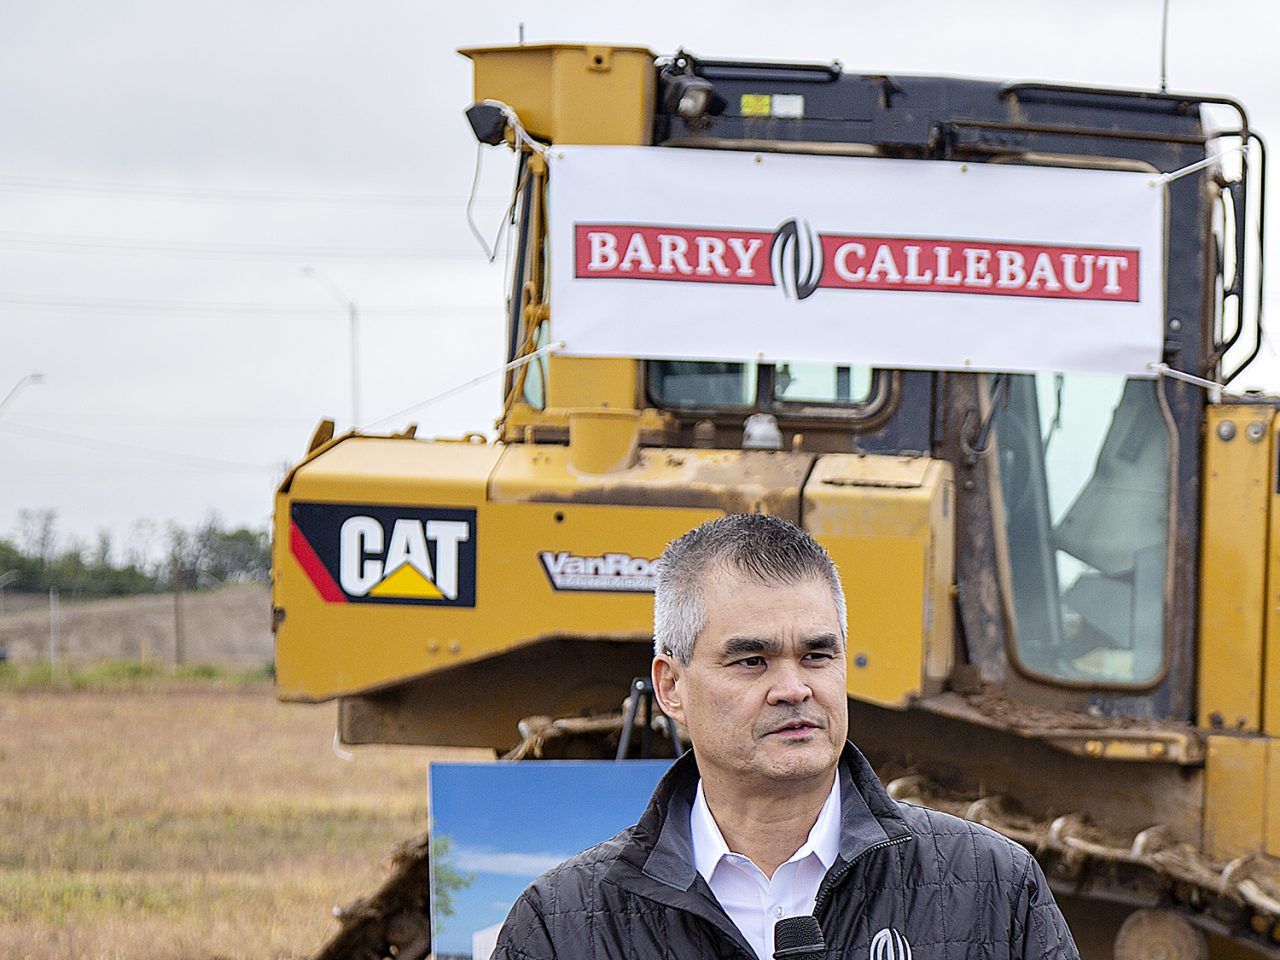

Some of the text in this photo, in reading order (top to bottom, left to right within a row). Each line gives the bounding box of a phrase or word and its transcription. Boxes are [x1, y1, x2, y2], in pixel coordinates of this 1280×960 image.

[587, 231, 1129, 293] BARRY CALLEBAUT
[339, 515, 470, 601] CAT
